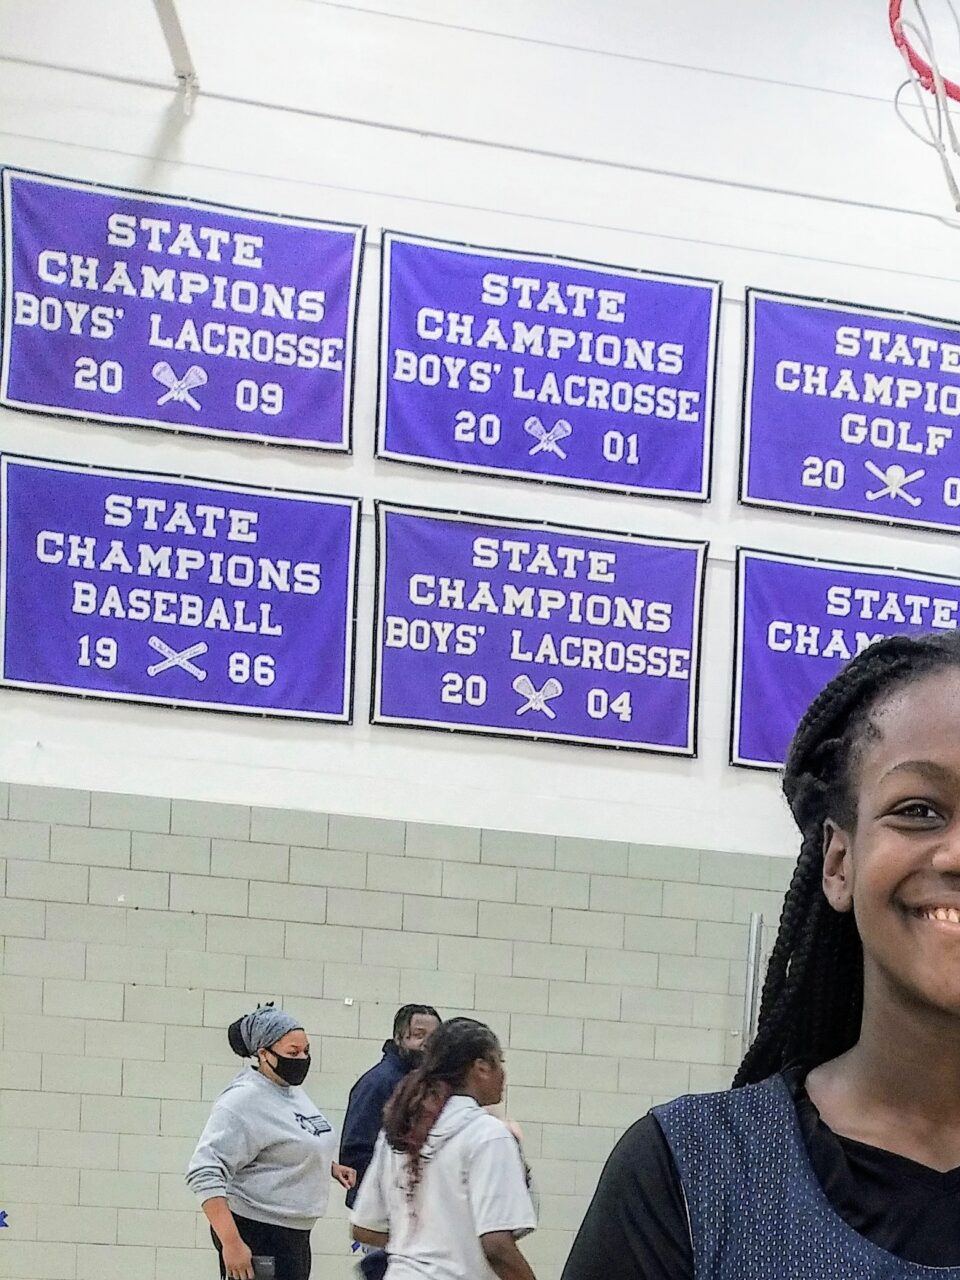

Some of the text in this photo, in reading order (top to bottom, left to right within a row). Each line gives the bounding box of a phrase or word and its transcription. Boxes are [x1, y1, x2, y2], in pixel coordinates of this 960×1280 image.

[107, 213, 264, 269] STATE
[37, 250, 325, 323] CHAMPIONS
[481, 273, 626, 323] STATE
[14, 291, 344, 371] BOYS' LACROSSE
[417, 307, 684, 375] CHAMPIONS
[74, 356, 284, 415] 20 09
[393, 348, 700, 422] BOYS' LACROSSE
[454, 410, 639, 464] 20 01
[840, 412, 953, 456] GOLF
[802, 456, 845, 490] 20
[104, 494, 258, 543] STATE
[36, 530, 321, 595] CHAMPIONS
[472, 537, 616, 583] STATE
[72, 581, 282, 636] BASEBALL
[409, 573, 672, 633] CHAMPIONS
[827, 586, 959, 629] STATE
[78, 635, 118, 669] 19
[228, 652, 276, 686] 86
[385, 615, 690, 680] BOYS' LACROSSE
[441, 672, 632, 722] 20 04
